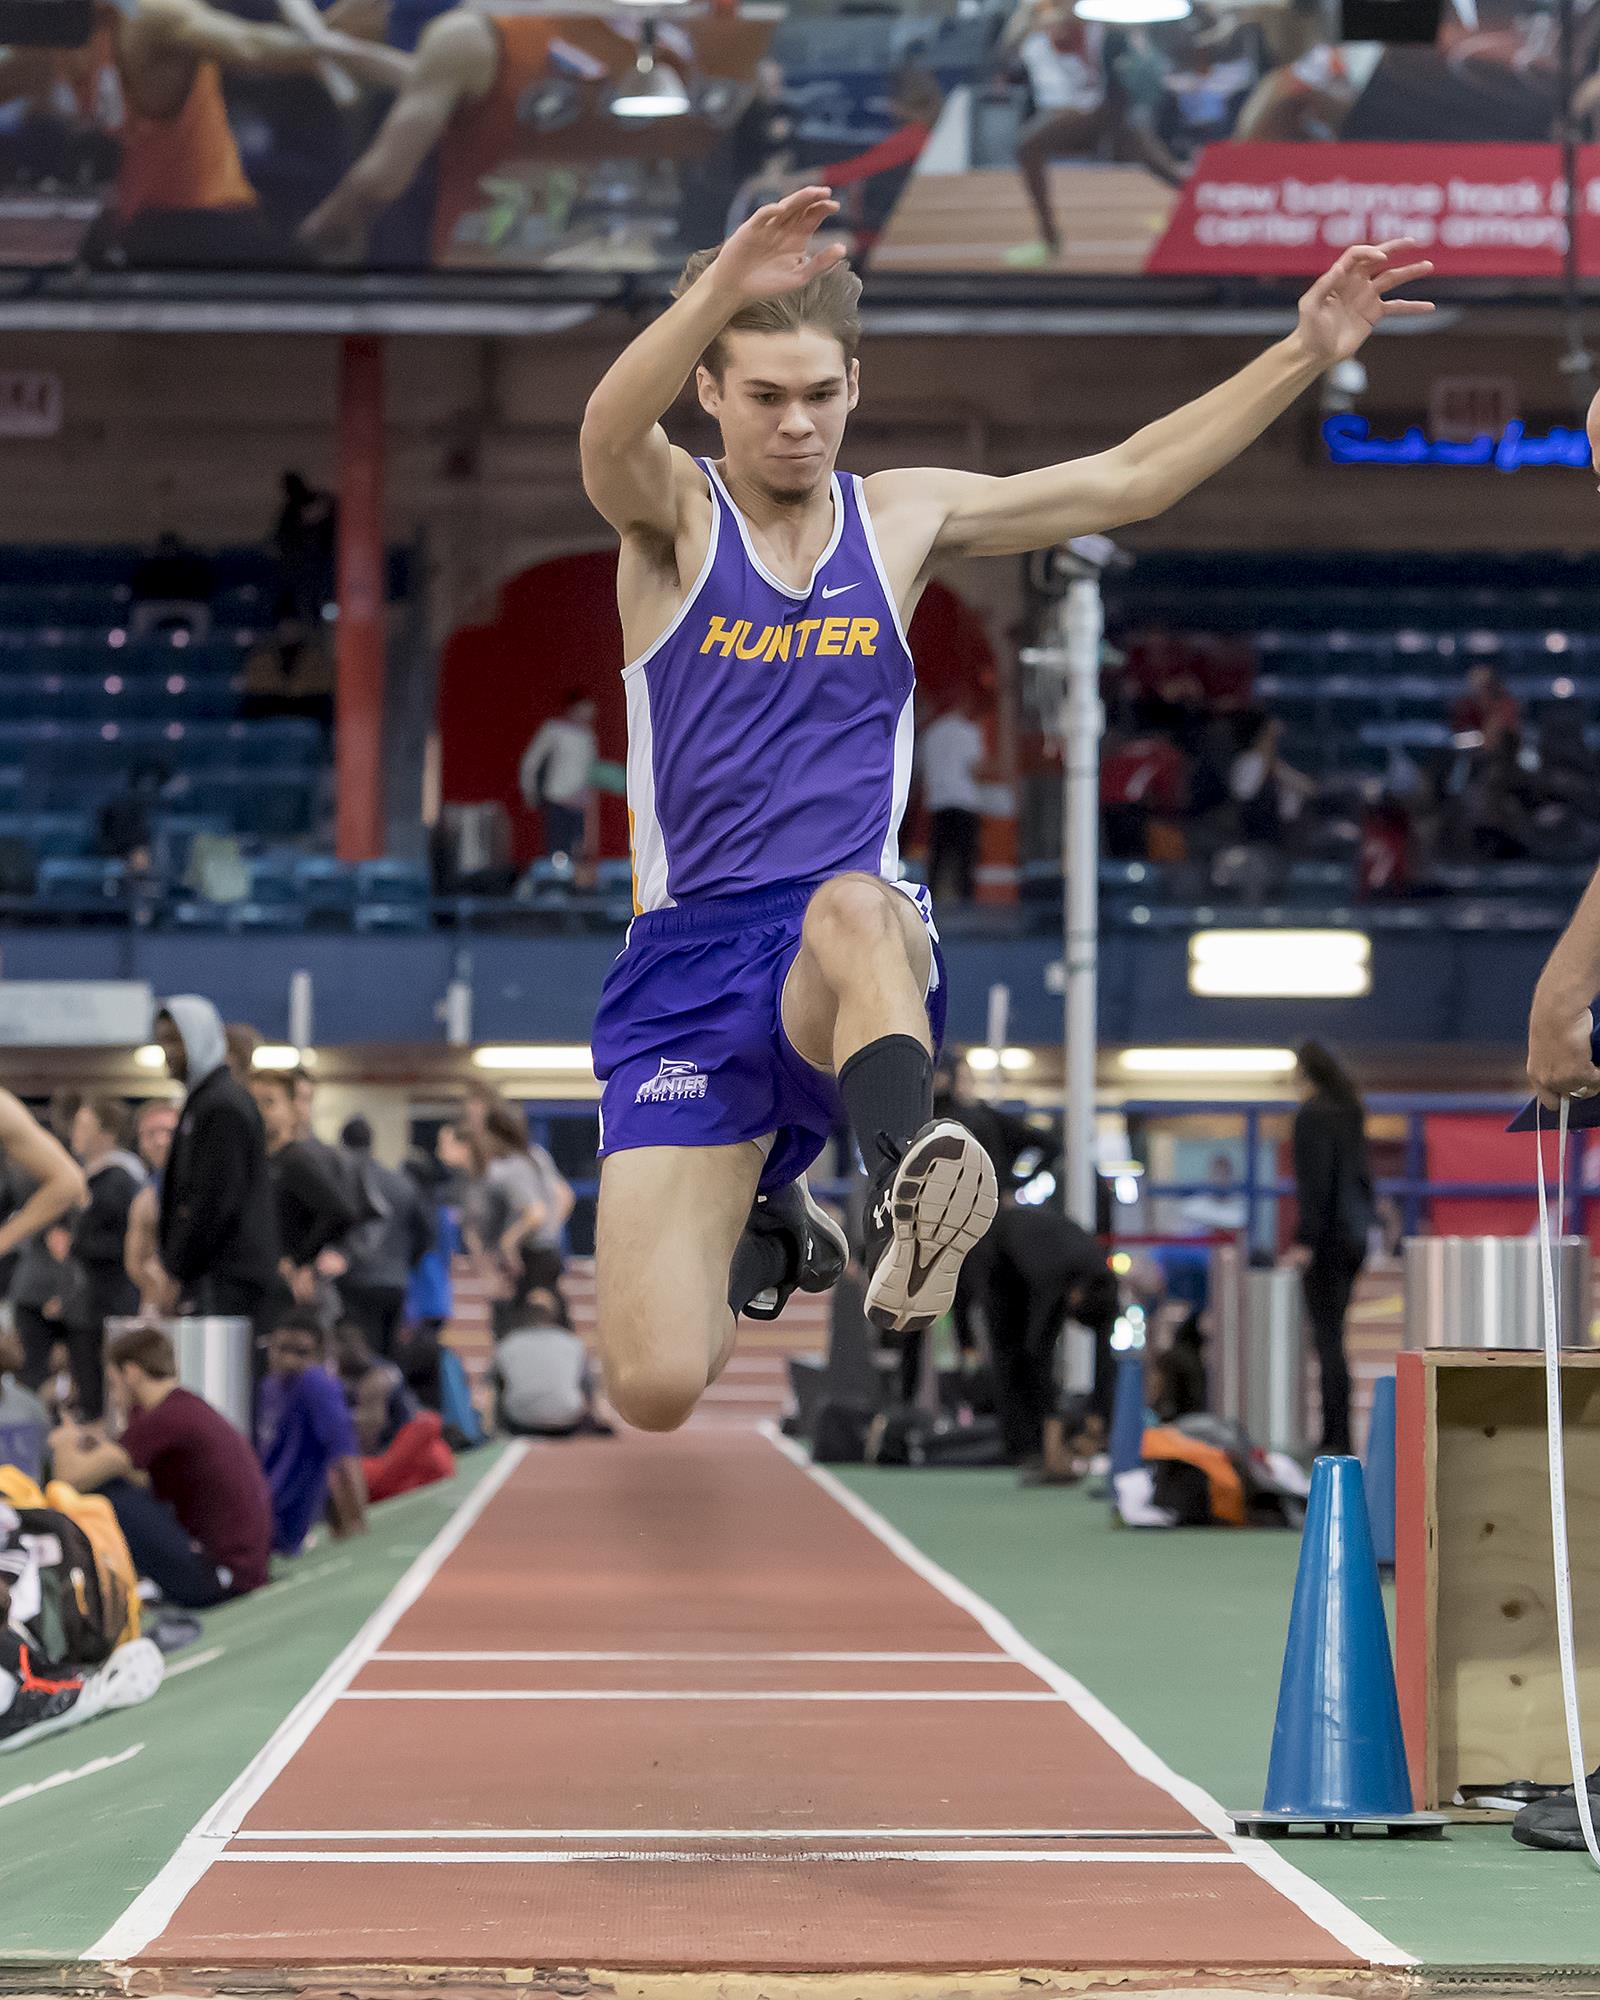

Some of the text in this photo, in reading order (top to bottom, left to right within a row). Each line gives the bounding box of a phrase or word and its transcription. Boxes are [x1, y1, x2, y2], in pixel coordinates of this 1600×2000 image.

[1283, 178, 1441, 214] balance
[700, 615, 880, 663] HUNTER
[634, 1089, 706, 1104] ATHLETICS
[637, 1073, 708, 1097] HUNTER
